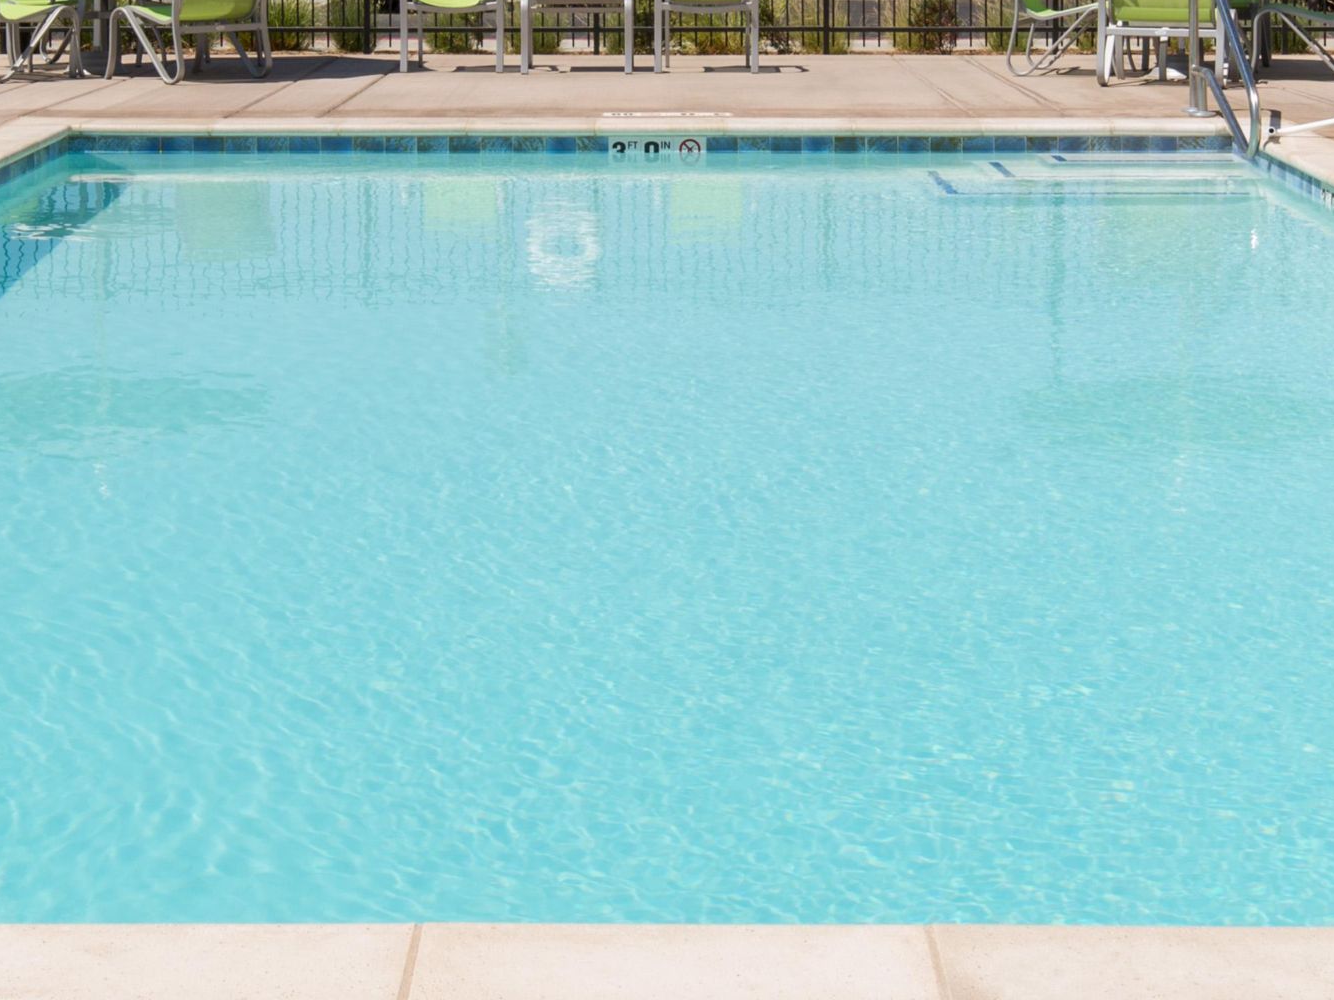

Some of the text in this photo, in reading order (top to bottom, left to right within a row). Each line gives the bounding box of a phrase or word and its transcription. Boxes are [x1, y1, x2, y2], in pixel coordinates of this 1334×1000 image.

[612, 141, 626, 153] 3
[628, 141, 638, 149] FT
[661, 141, 671, 149] IN
